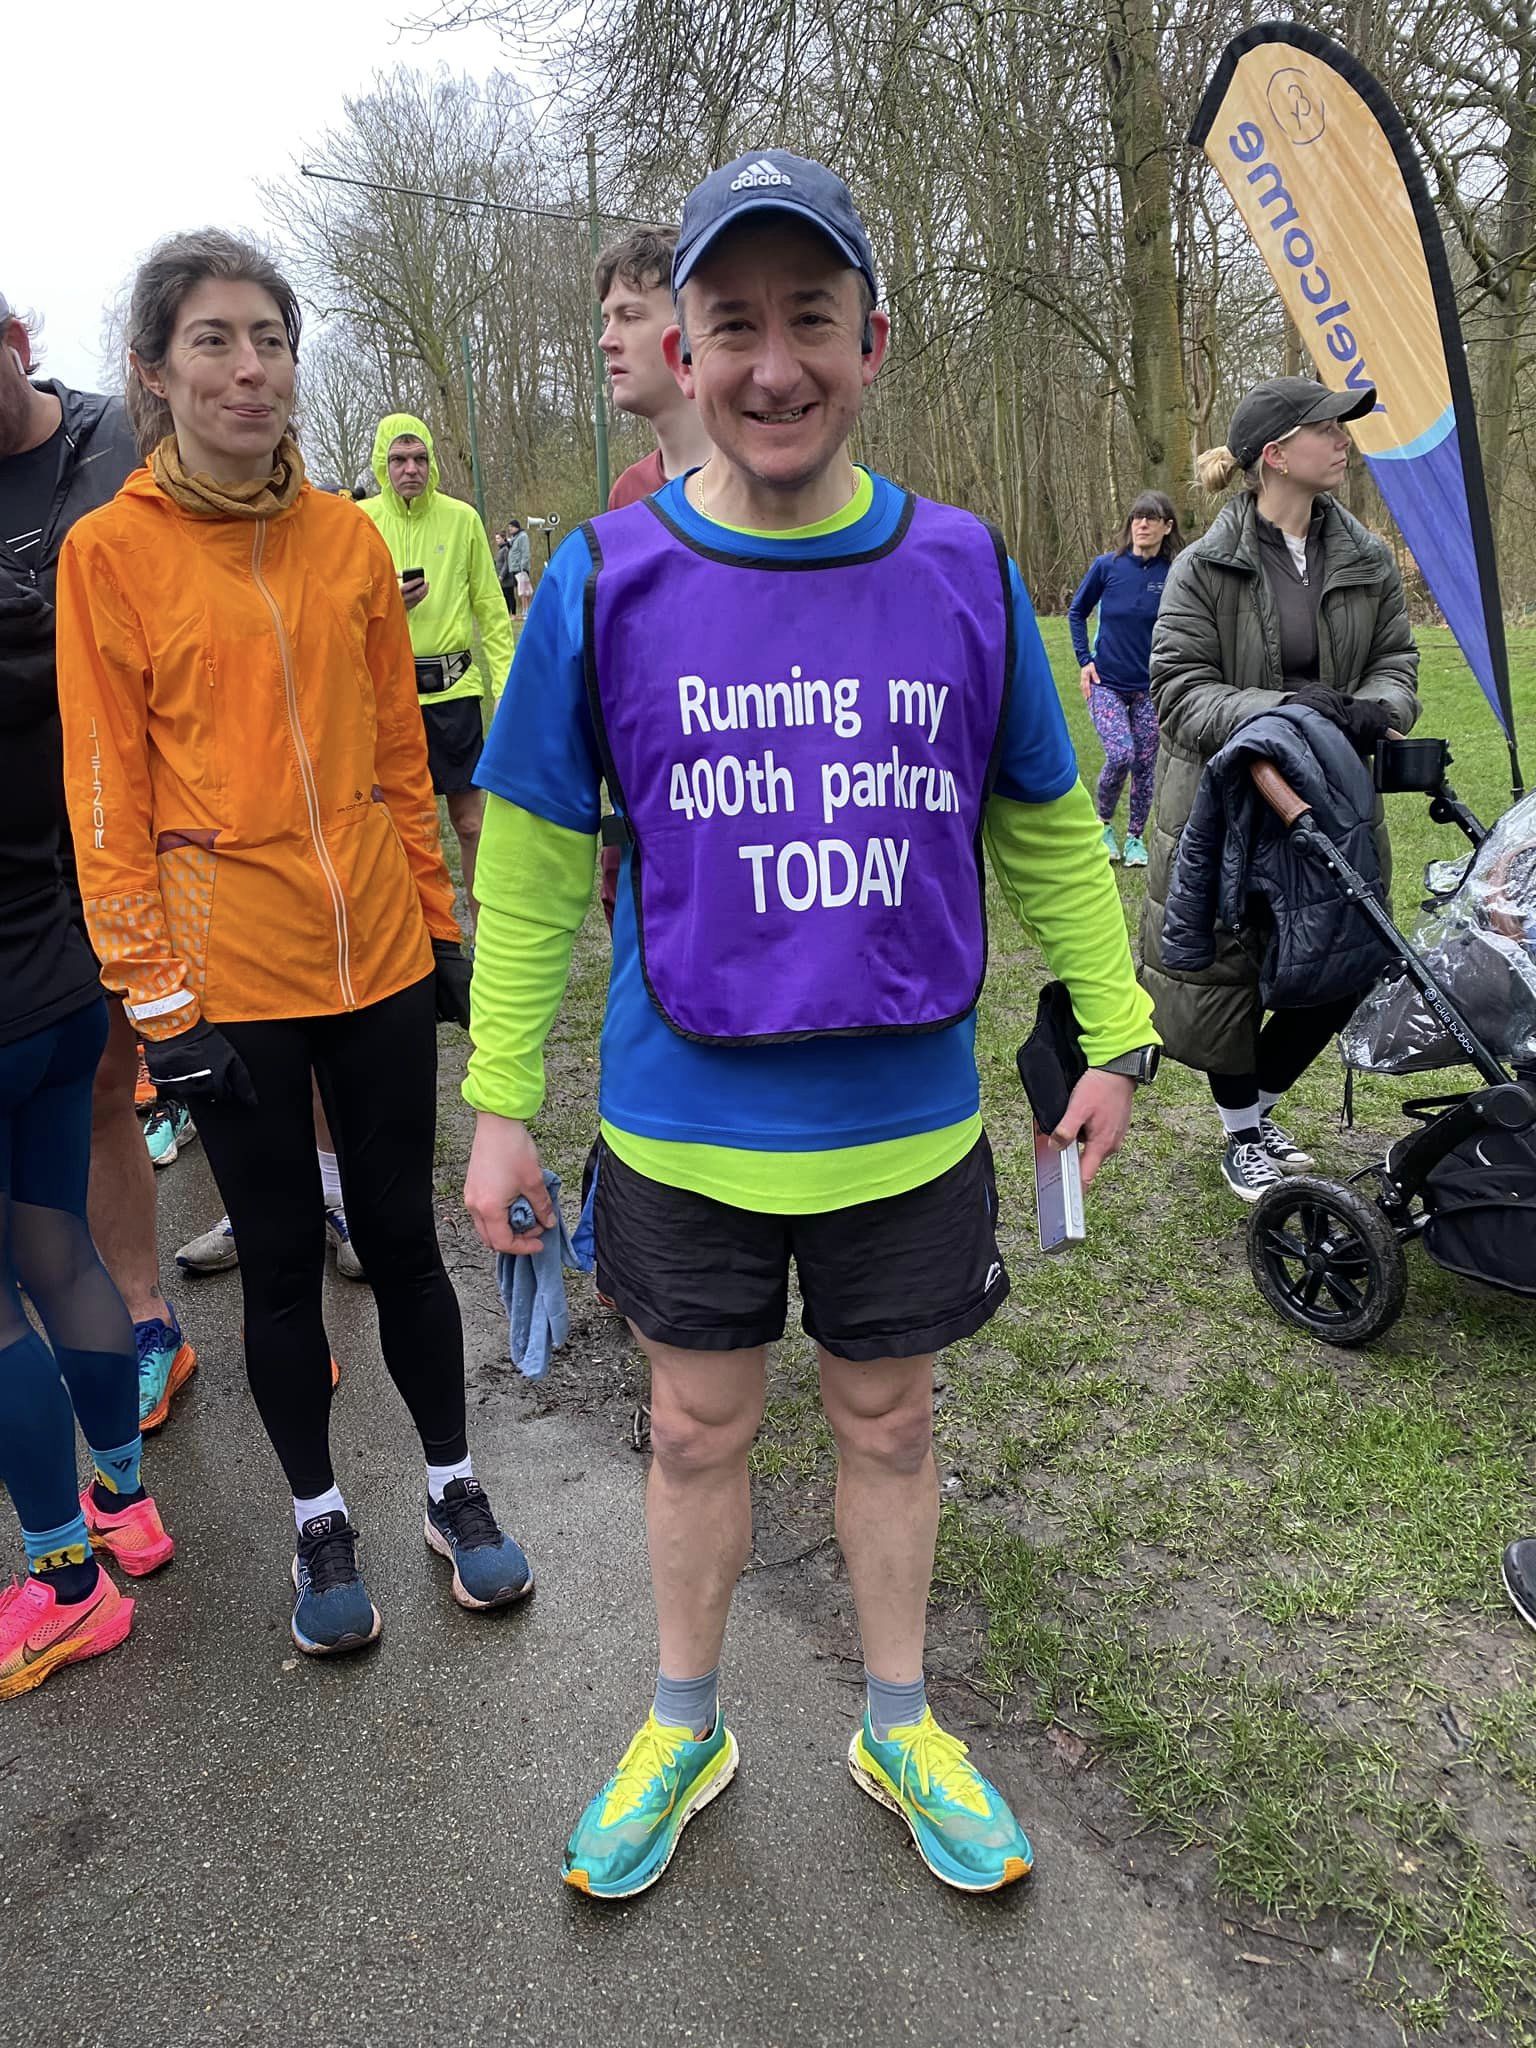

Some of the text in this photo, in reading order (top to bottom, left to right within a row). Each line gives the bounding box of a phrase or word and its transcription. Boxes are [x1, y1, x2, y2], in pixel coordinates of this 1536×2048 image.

[730, 173, 792, 192] adidas
[678, 665, 949, 743] Running my
[89, 716, 105, 848] RONHILL
[669, 745, 960, 823] 400th parkrun
[738, 838, 909, 913] TODAY
[1433, 1000, 1474, 1054] ickle bubbo
